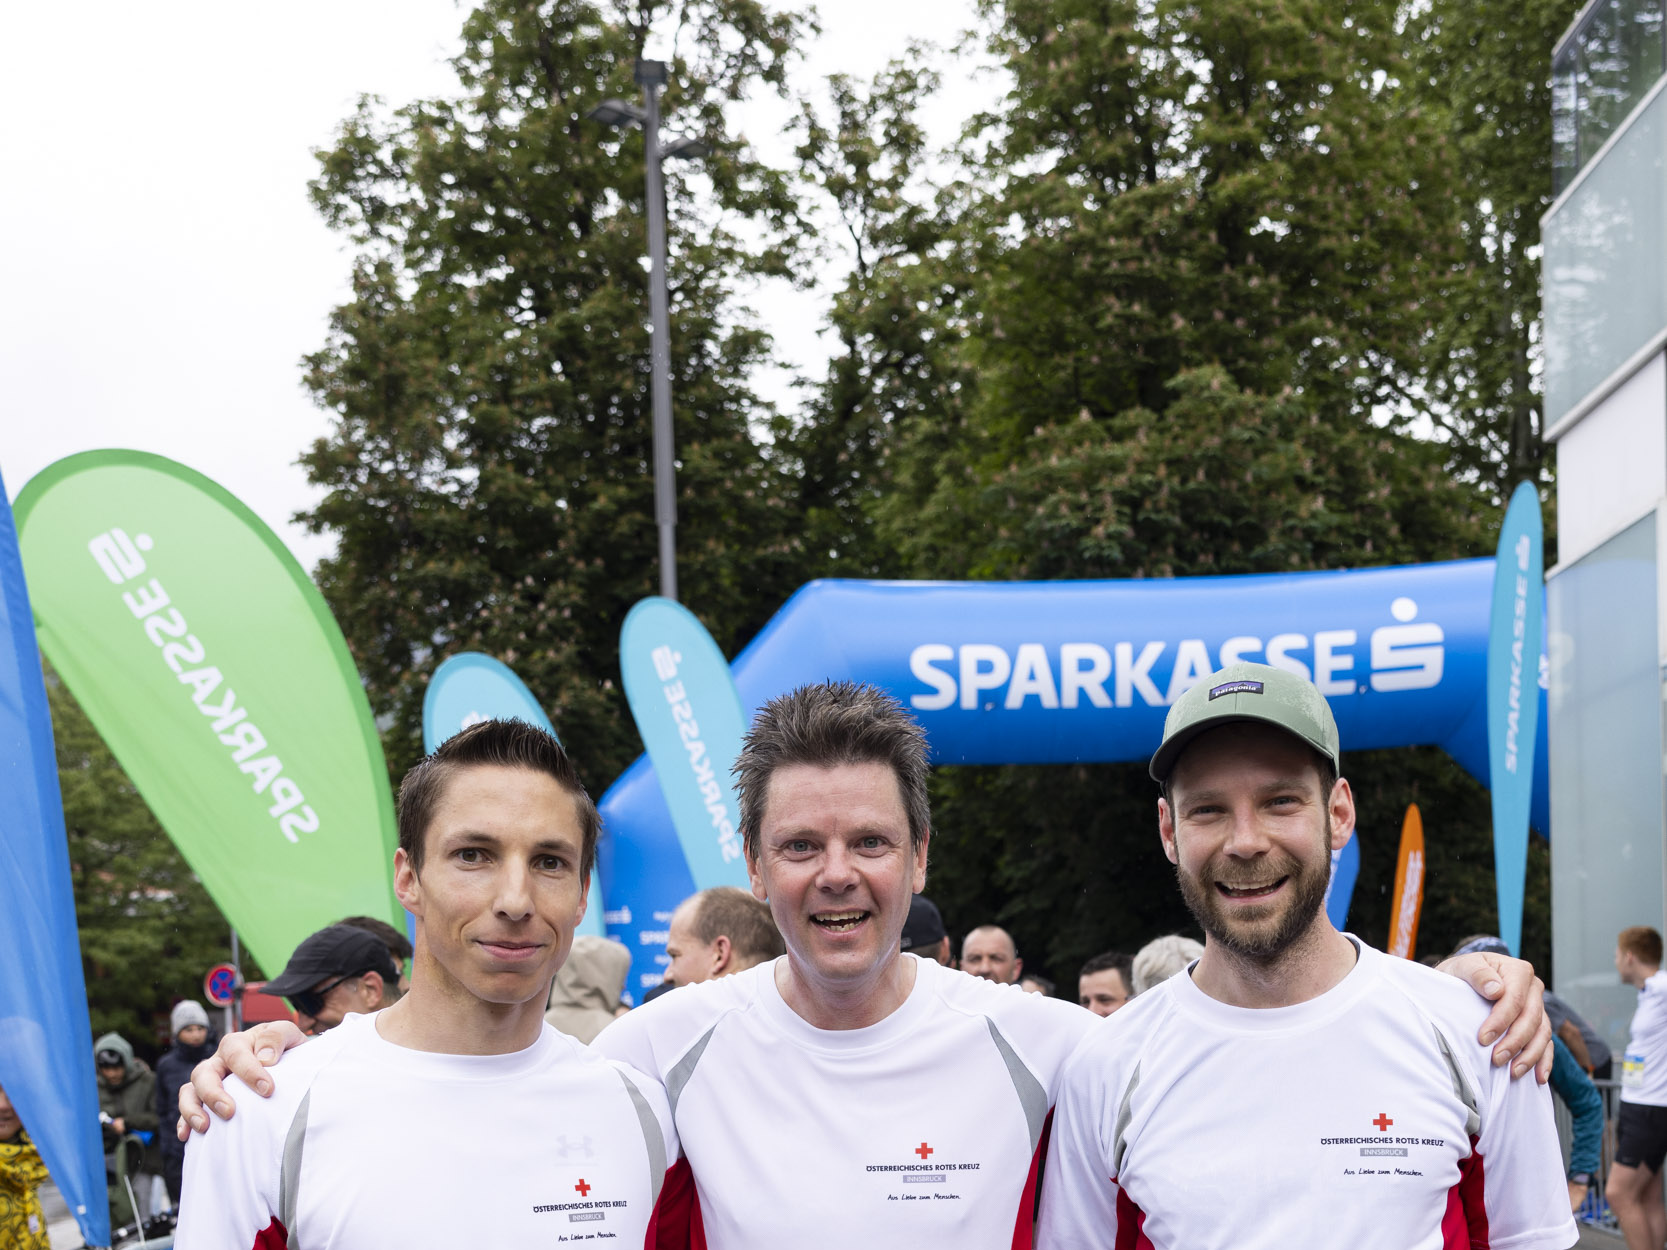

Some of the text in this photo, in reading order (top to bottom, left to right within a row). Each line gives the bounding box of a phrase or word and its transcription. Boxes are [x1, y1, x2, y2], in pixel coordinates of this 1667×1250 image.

[1505, 574, 1528, 774] SPARKASSE
[1215, 684, 1257, 697] patagonia
[1320, 1137, 1444, 1146] ÖSTERREICHISCHES ROTES KREUZ
[1364, 1148, 1404, 1156] INNSBRUCK
[866, 1164, 933, 1172] ÖSTERREICHISCHES
[935, 1163, 956, 1171] ROTES
[1358, 1167, 1375, 1175] Liebe
[906, 1174, 942, 1182] INNSBRUCK
[887, 1193, 898, 1201] Aus
[532, 1200, 627, 1213] ÖSTERREICHISCHES ROTES KREUZ
[572, 1212, 602, 1221] INNSBRUCK
[558, 1234, 568, 1242] Aus
[570, 1233, 583, 1241] Liebe
